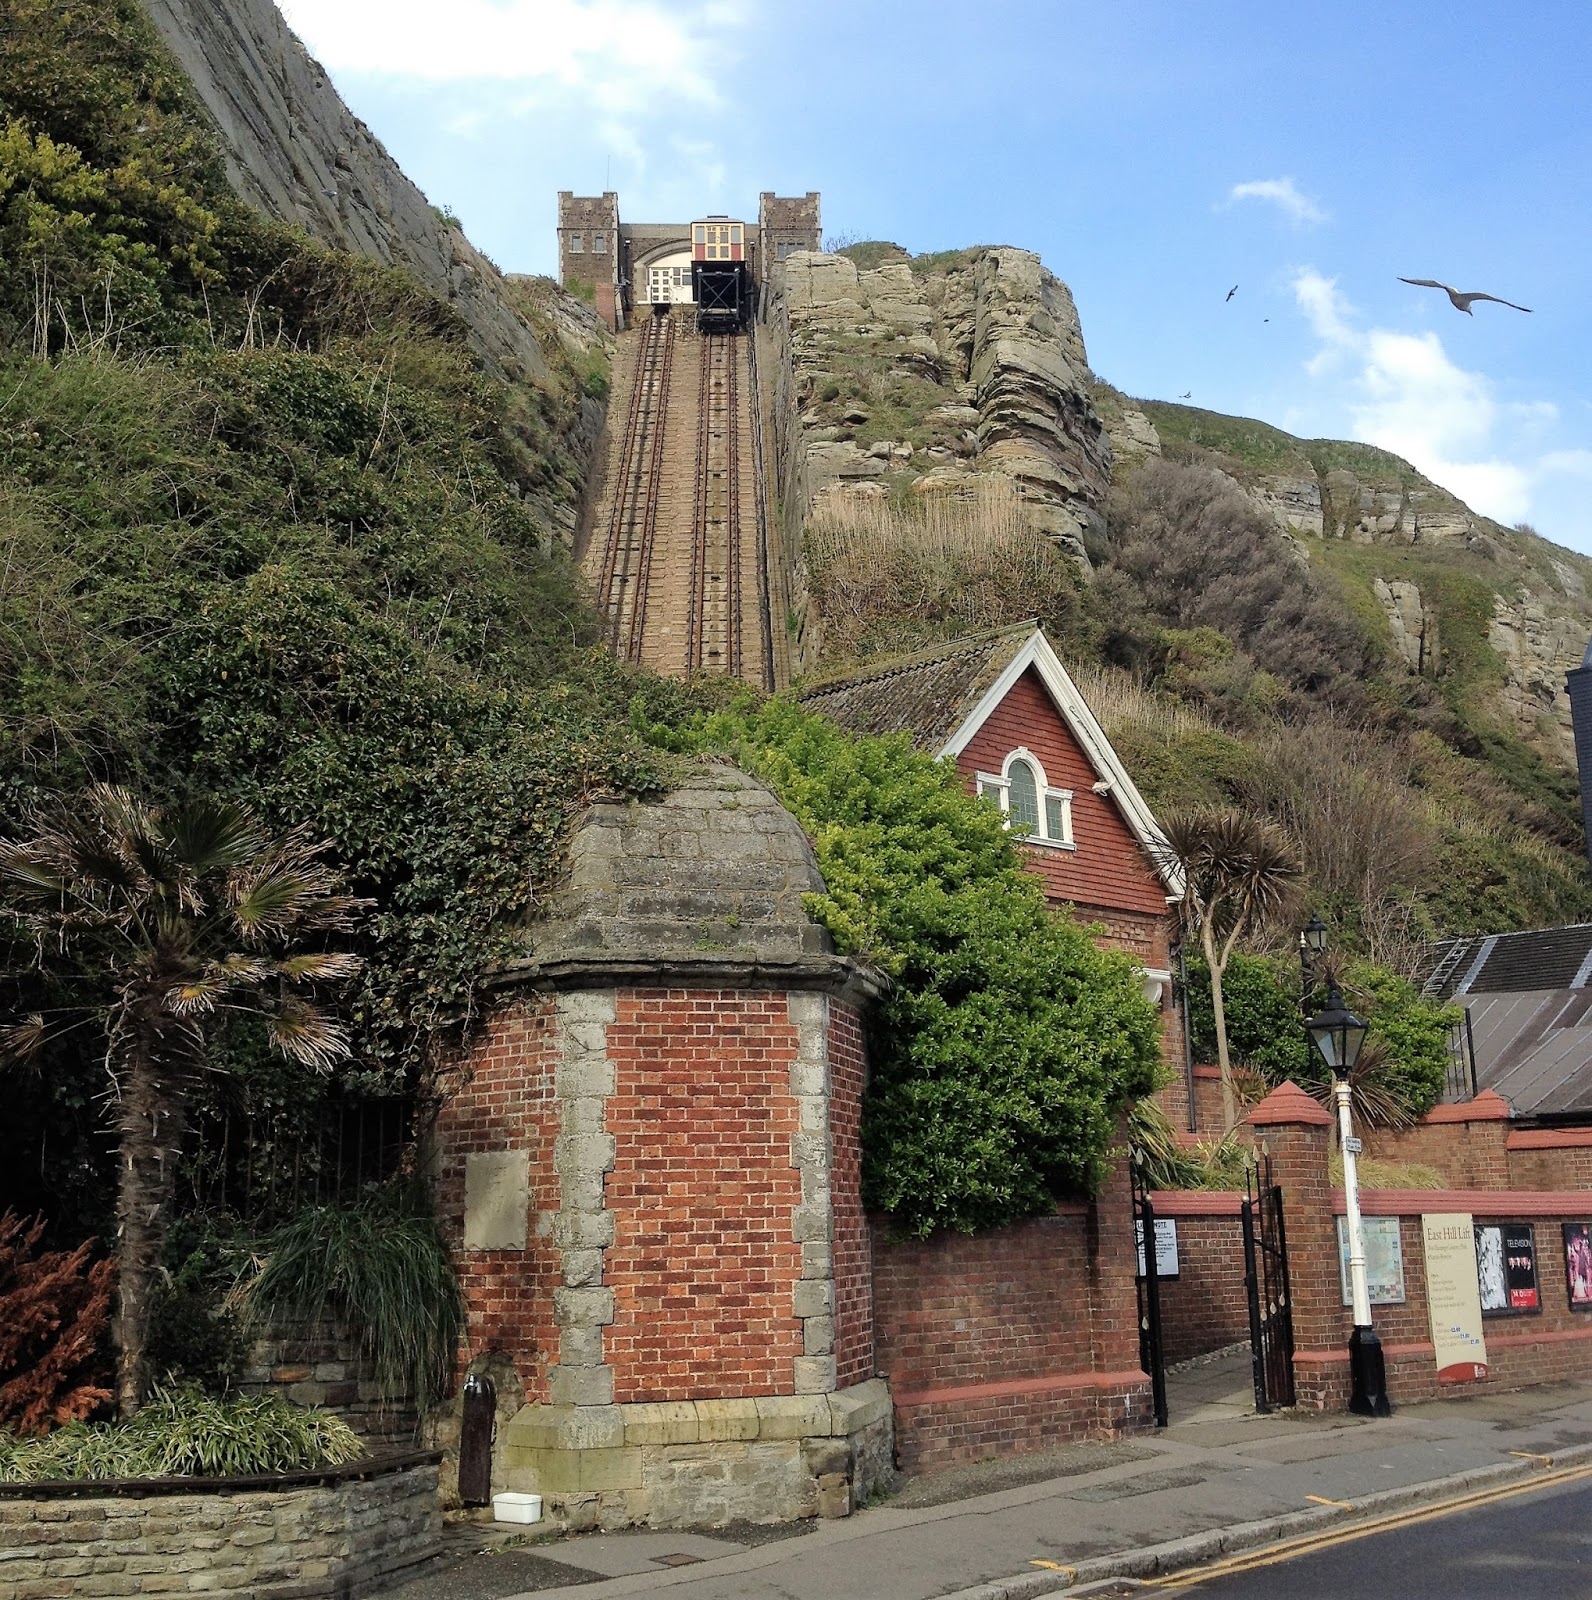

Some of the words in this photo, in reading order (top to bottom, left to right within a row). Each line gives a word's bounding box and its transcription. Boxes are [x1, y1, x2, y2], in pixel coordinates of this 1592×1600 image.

[1427, 1227, 1442, 1240] East
[1443, 1226, 1457, 1240] Hill
[1458, 1225, 1471, 1239] Lift
